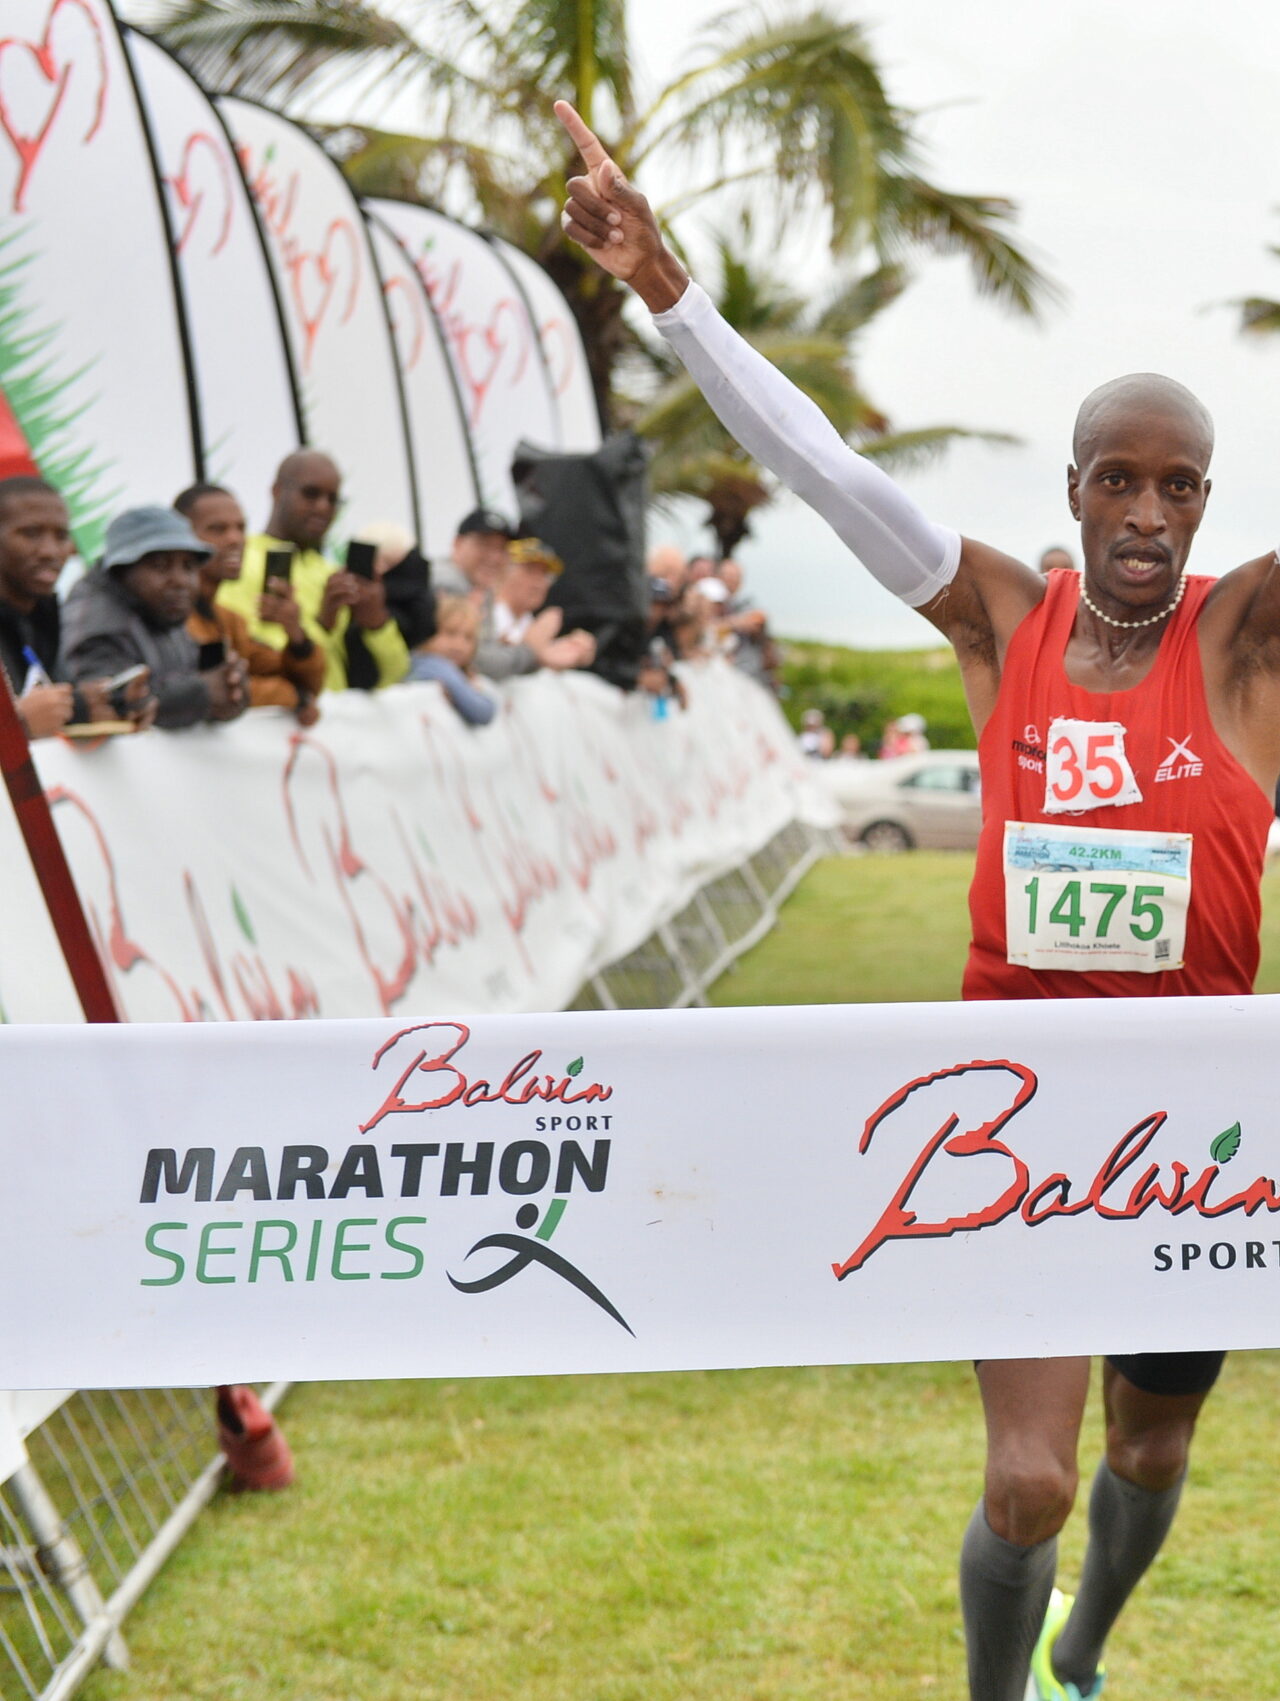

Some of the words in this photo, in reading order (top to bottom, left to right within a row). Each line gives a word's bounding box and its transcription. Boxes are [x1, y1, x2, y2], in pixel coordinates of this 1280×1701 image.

[1051, 735, 1124, 802] 35
[1154, 763, 1204, 783] ELITE
[1068, 845, 1123, 861] 42.2KM
[1025, 877, 1165, 941] 1475
[359, 1021, 613, 1134] Balwin
[535, 1114, 613, 1131] SPORT
[139, 1139, 611, 1204] MARATHON
[140, 1216, 427, 1286] SERIES
